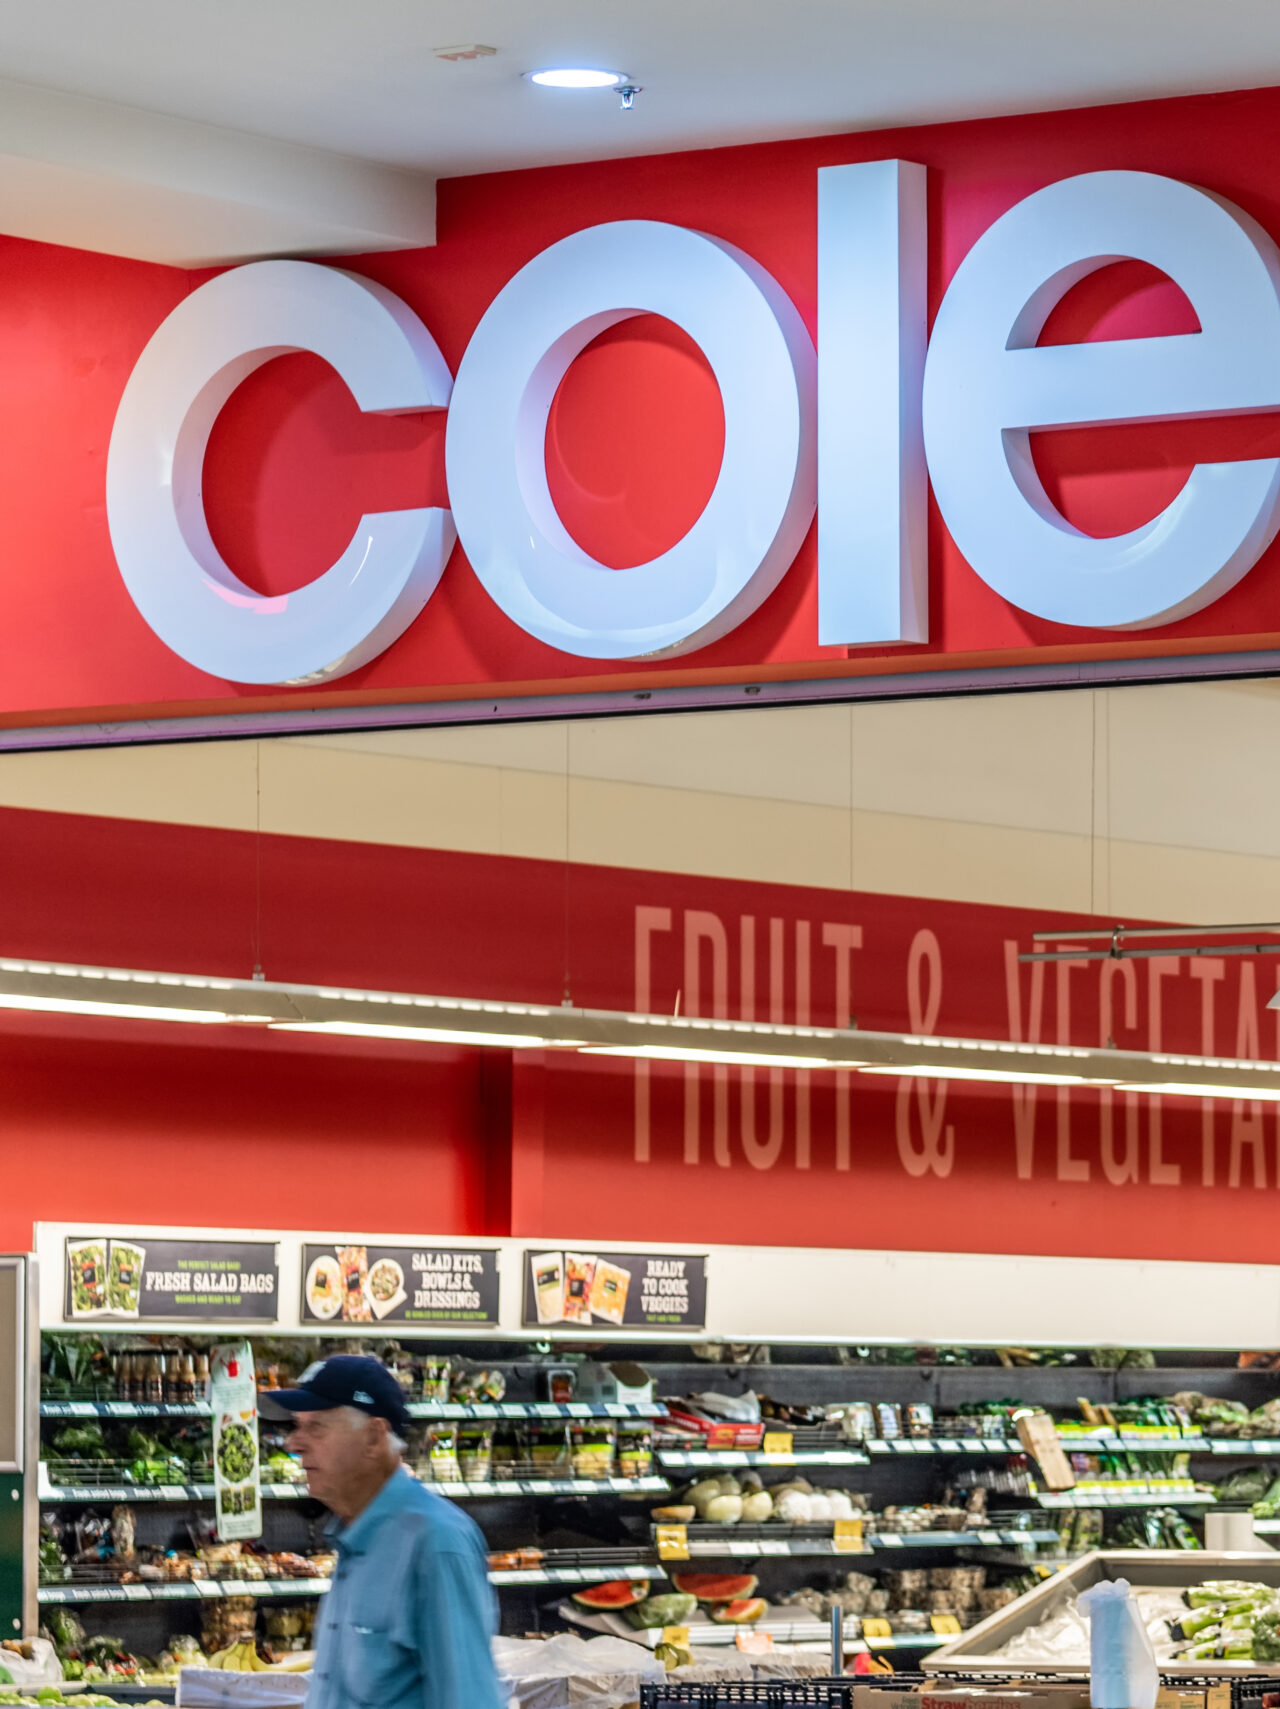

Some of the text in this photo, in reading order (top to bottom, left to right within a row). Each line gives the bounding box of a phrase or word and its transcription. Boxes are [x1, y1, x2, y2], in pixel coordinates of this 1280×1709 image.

[634, 905, 862, 1171] FRUIT
[896, 928, 955, 1179] &
[411, 1253, 484, 1274] SALAD KITS,
[647, 1260, 686, 1278] READY
[146, 1272, 274, 1294] FRESH SALAD BAGS
[422, 1272, 460, 1289] BOWLS
[642, 1278, 689, 1295] TO COOK
[414, 1291, 480, 1309] DRESSINGS
[640, 1295, 689, 1314] VEGGIES
